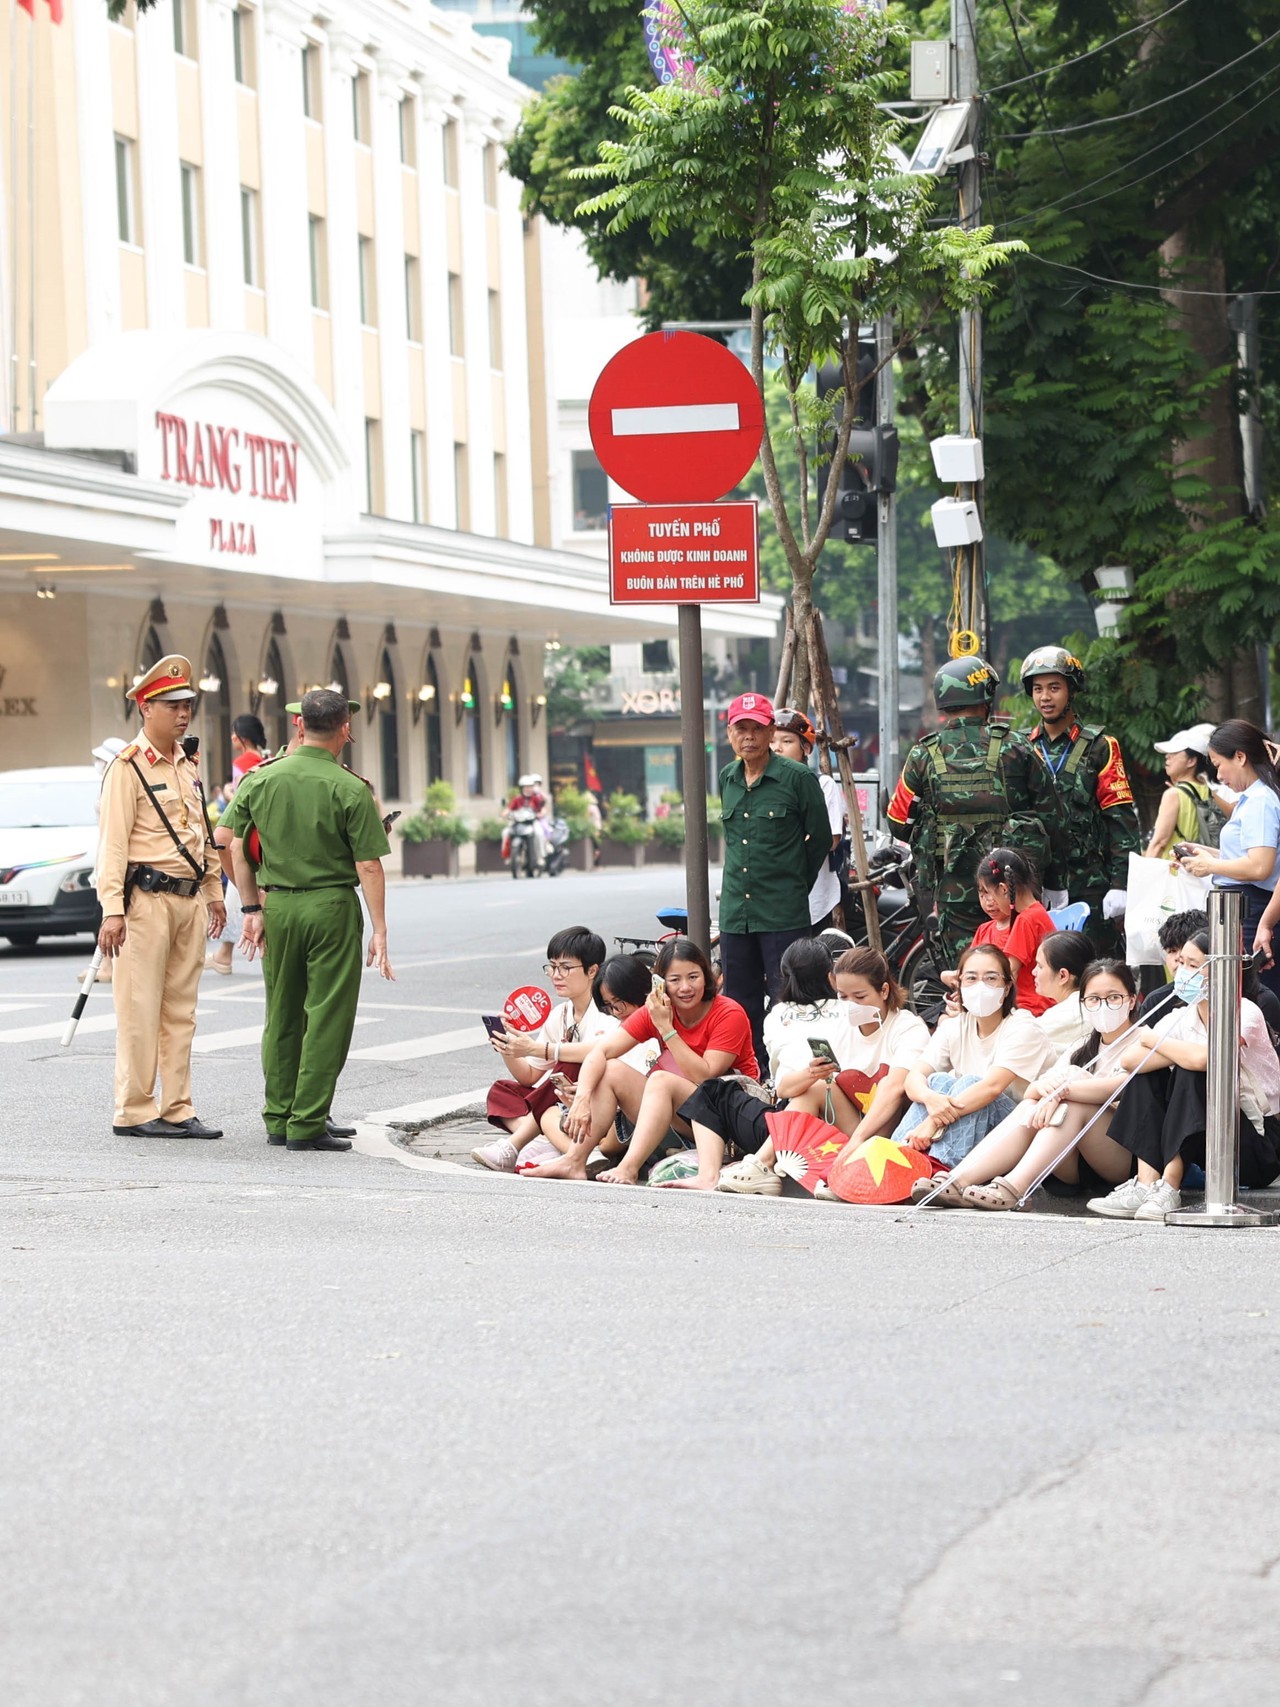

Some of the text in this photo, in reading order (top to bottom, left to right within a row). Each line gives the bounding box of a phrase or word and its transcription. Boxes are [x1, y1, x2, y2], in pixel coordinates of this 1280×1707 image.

[155, 411, 300, 504] TRANG TIEN
[209, 517, 257, 556] PLAZA
[648, 518, 690, 538] TUYẾN
[620, 548, 748, 565] KHÔNG ĐƯỢC KINH DOANH
[626, 572, 744, 590] BUÔN BÁN TRÊN HÈ PHỐ
